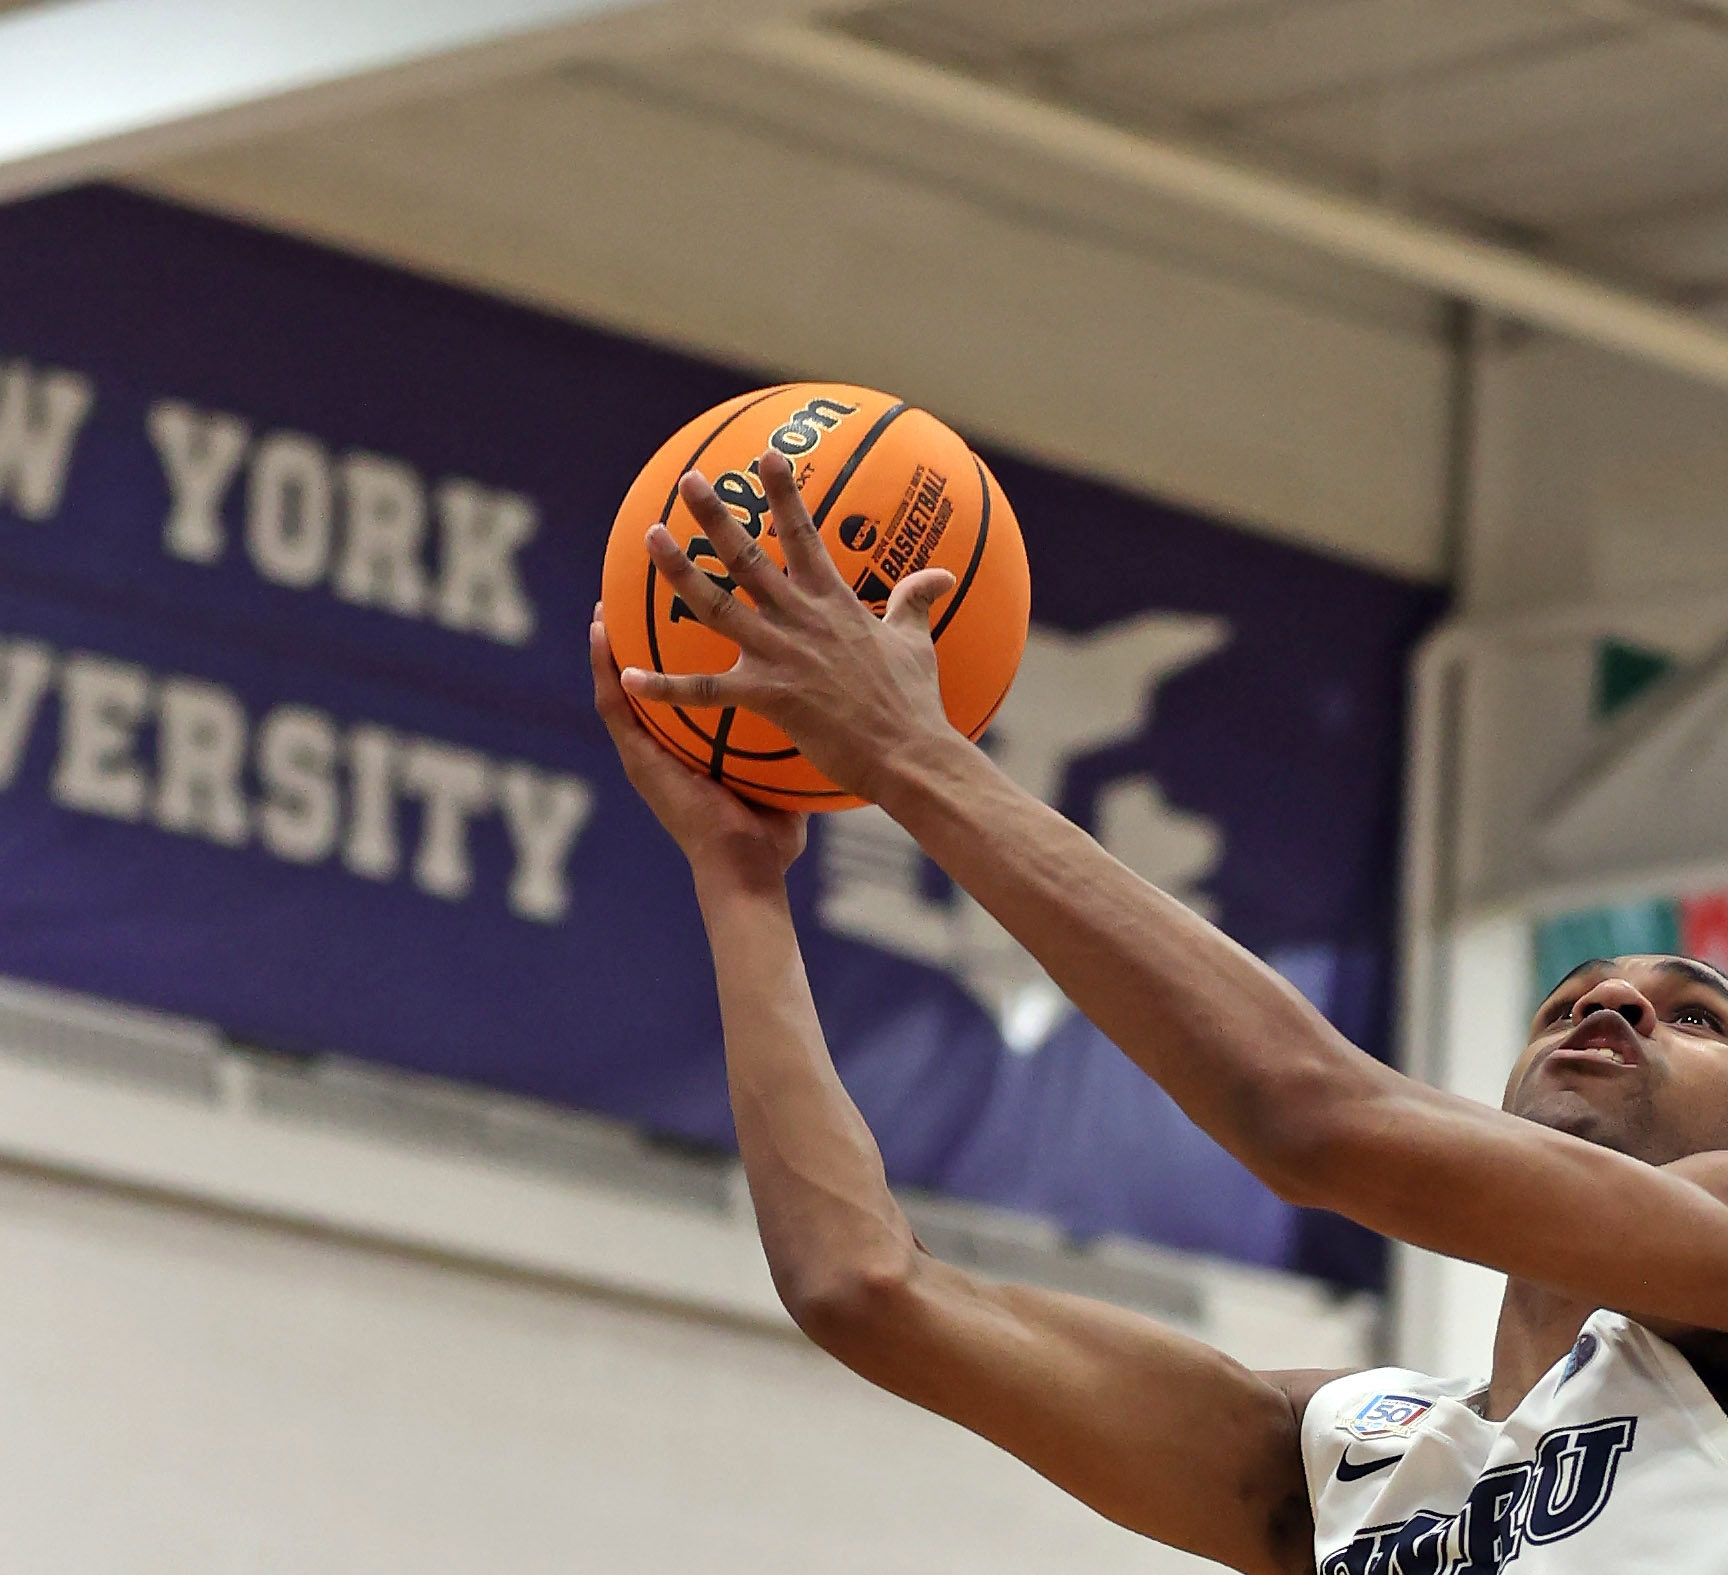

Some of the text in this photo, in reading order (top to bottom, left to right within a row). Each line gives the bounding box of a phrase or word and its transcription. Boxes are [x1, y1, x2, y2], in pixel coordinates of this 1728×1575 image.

[149, 399, 540, 646] YORK
[880, 468, 948, 582] BASKETBALL
[1366, 1404, 1412, 1423] 50
